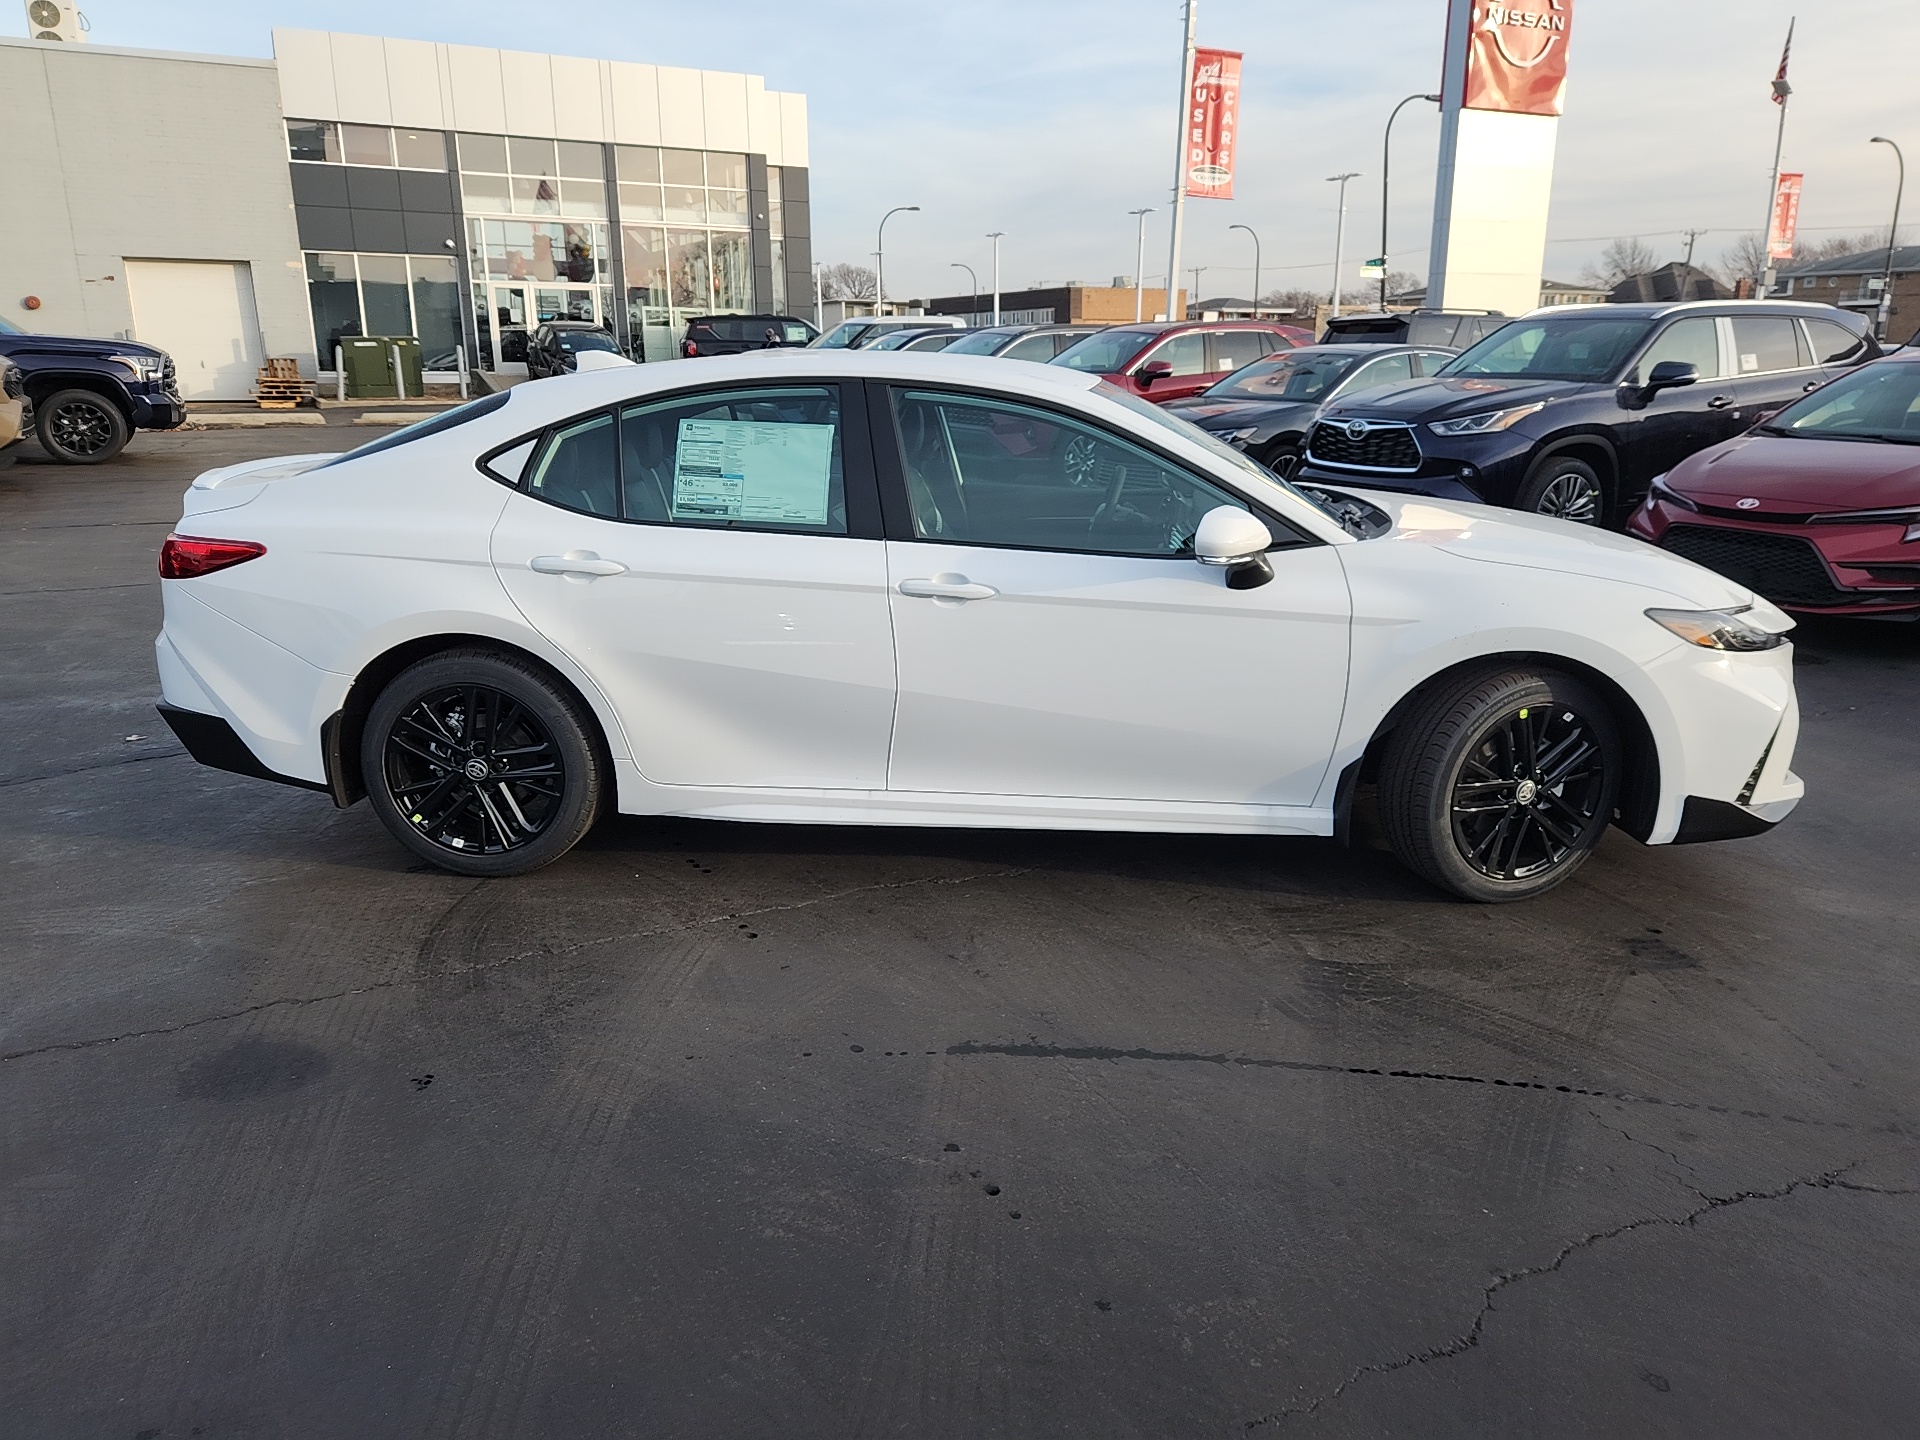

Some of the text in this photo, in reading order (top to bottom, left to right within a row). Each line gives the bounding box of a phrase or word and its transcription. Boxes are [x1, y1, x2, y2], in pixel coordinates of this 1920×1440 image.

[1488, 6, 1565, 31] NISSAN
[1191, 87, 1208, 162] USED
[1219, 90, 1235, 165] CARS
[1773, 195, 1785, 239] US
